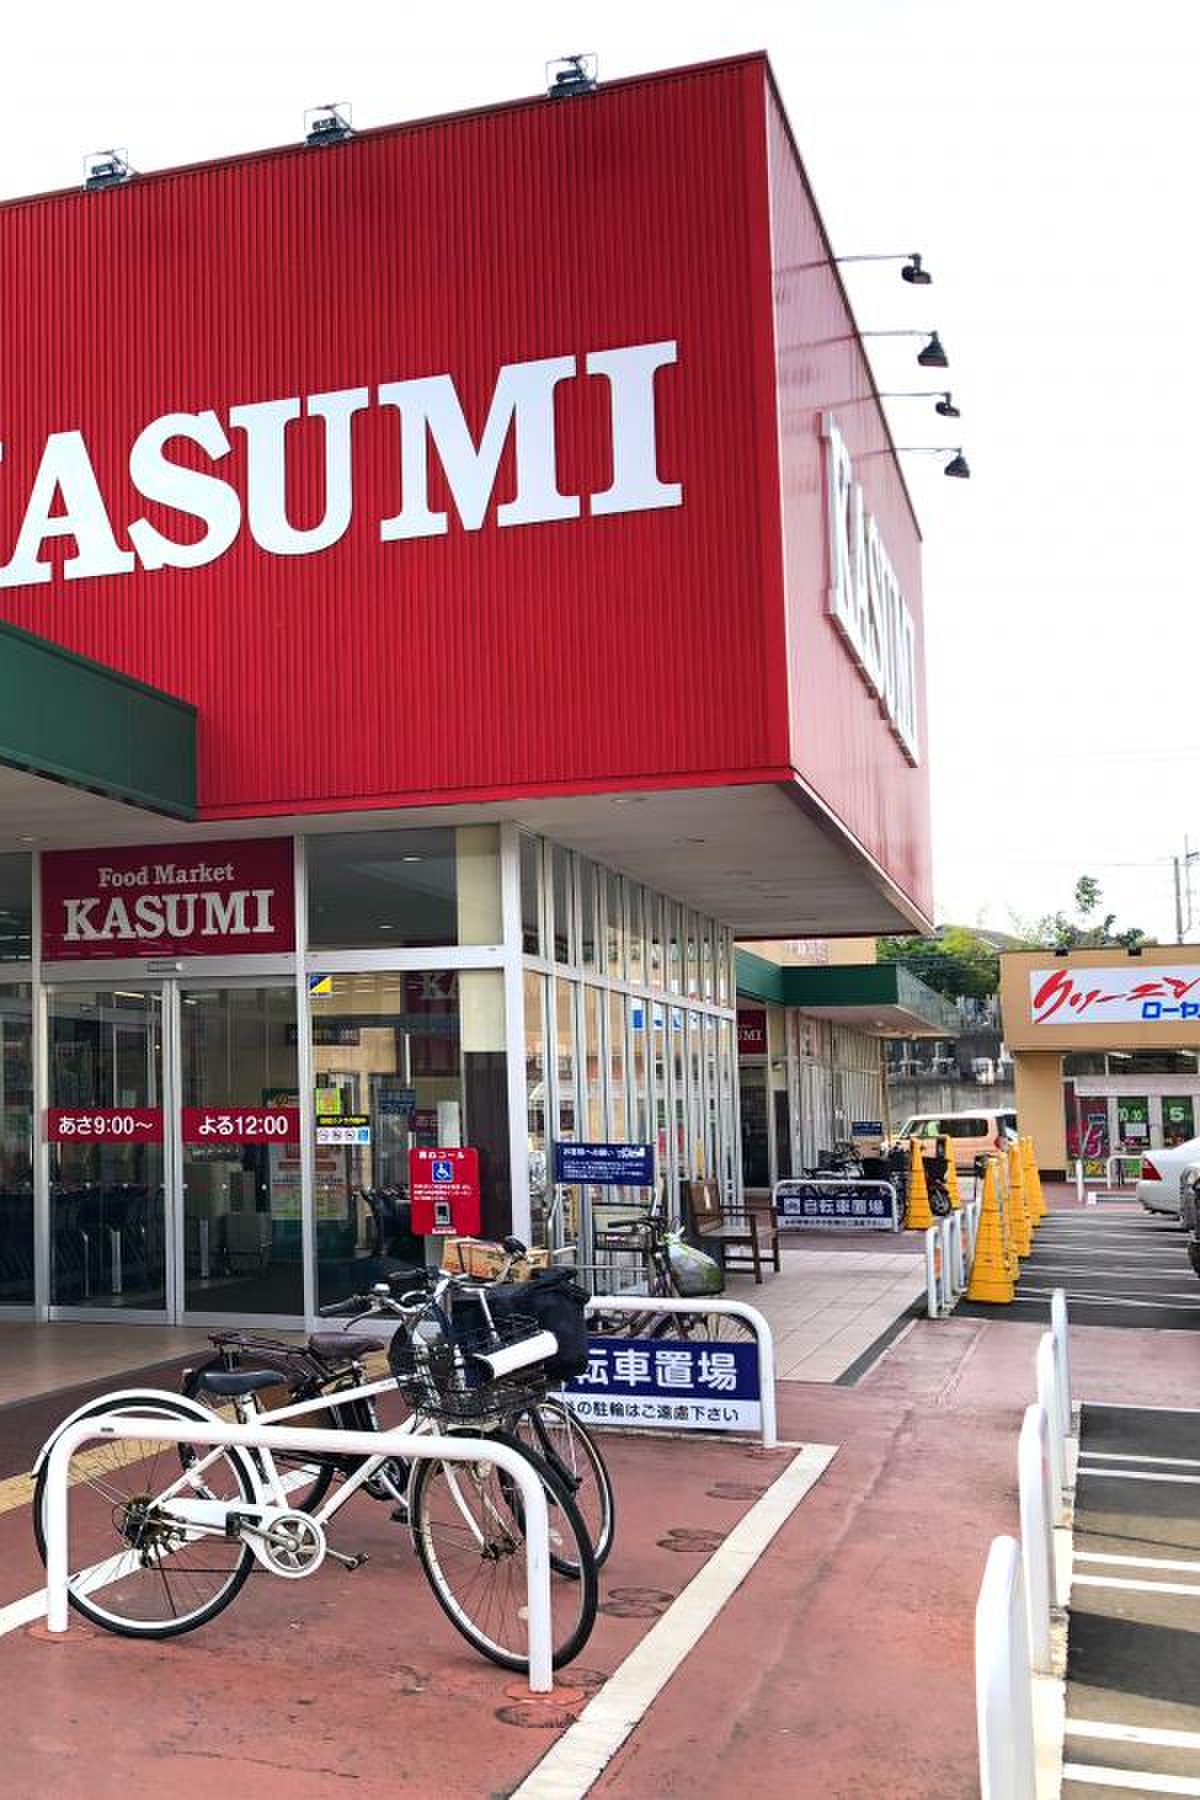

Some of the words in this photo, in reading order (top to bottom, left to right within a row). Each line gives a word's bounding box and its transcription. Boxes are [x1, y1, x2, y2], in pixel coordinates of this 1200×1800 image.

[98, 867, 149, 887] Food
[154, 863, 235, 885] Market
[64, 889, 275, 941] KASUMI
[198, 1115, 289, 1135] よる12:00
[575, 1348, 738, 1391] 転車置場
